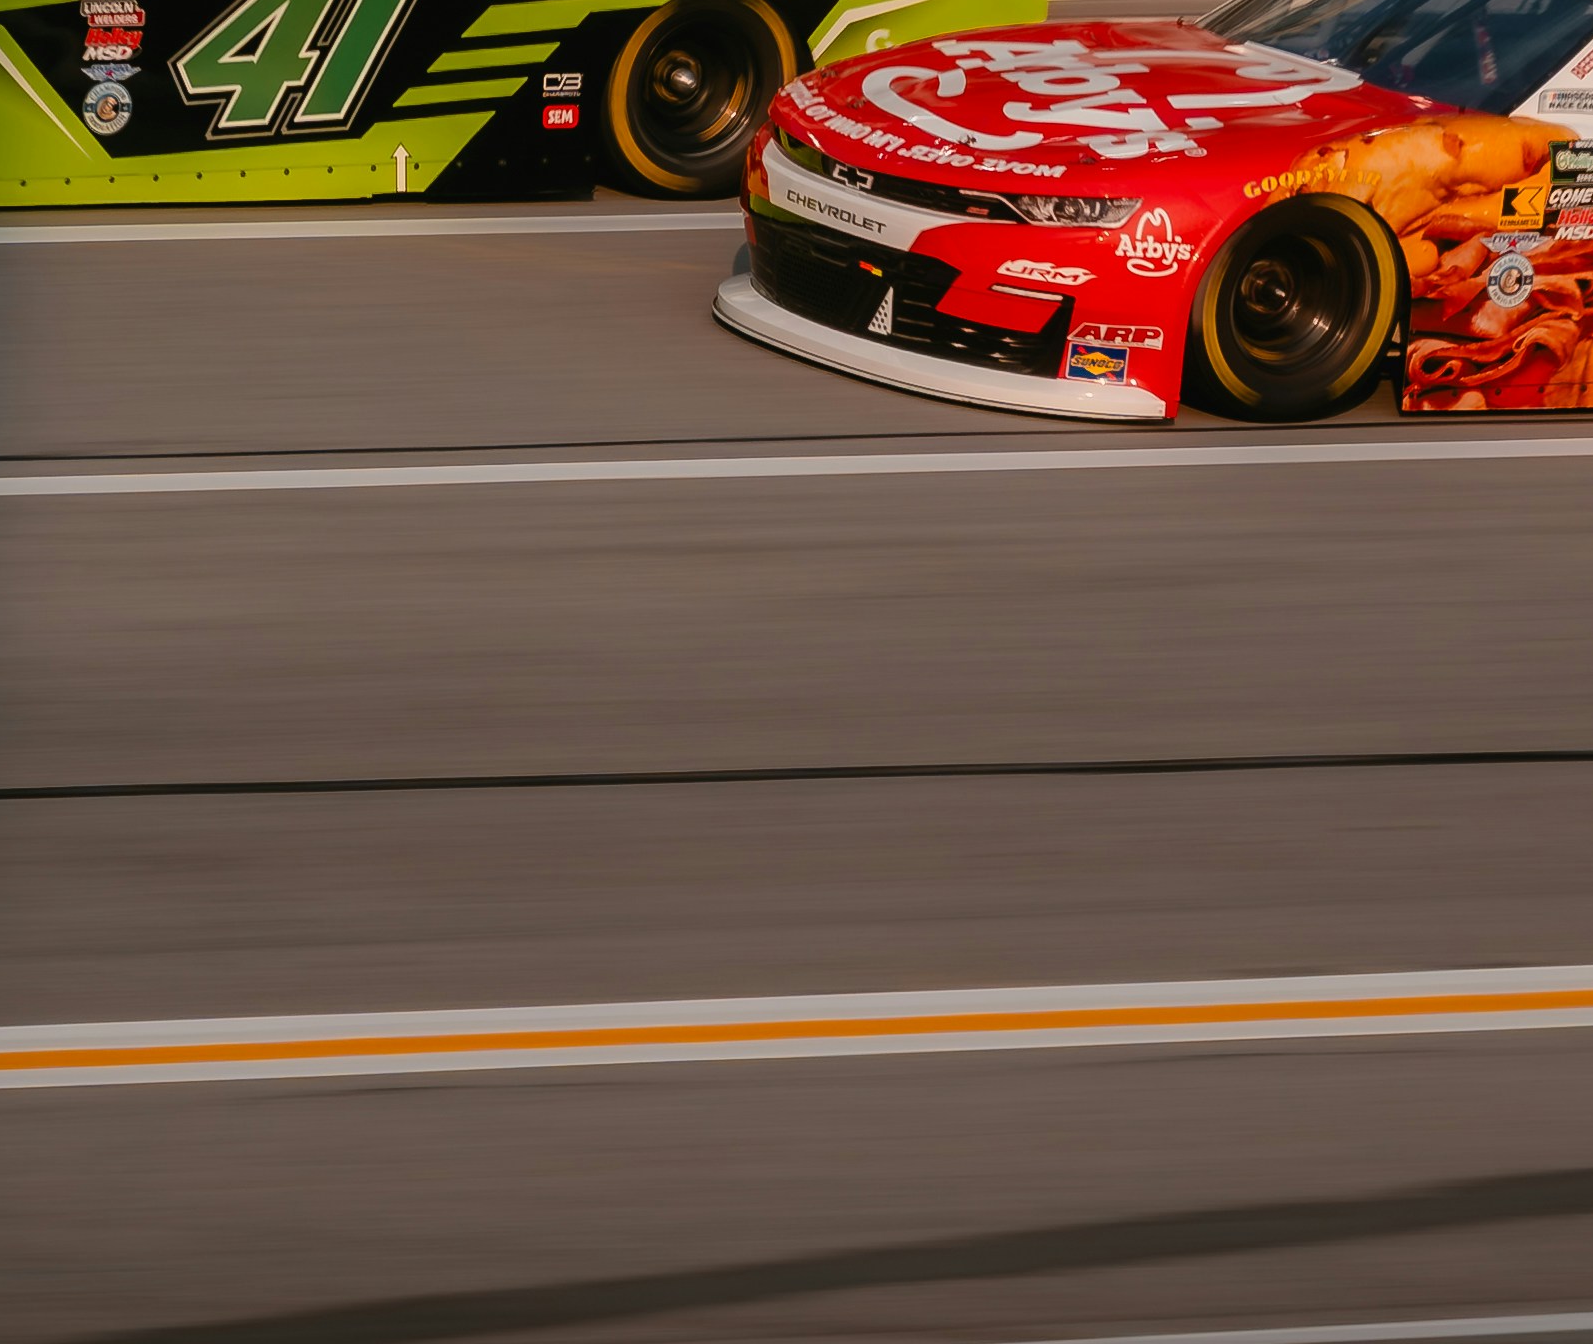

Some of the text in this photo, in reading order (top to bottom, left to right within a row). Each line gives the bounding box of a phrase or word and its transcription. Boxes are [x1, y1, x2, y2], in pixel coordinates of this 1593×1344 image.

[82, 44, 133, 61] MSD
[786, 189, 887, 234] CHEVROLET
[1114, 232, 1193, 265] Arby's
[1004, 265, 1080, 282] JRM
[1071, 324, 1162, 344] ARP
[1072, 355, 1124, 370] SUNOCO
